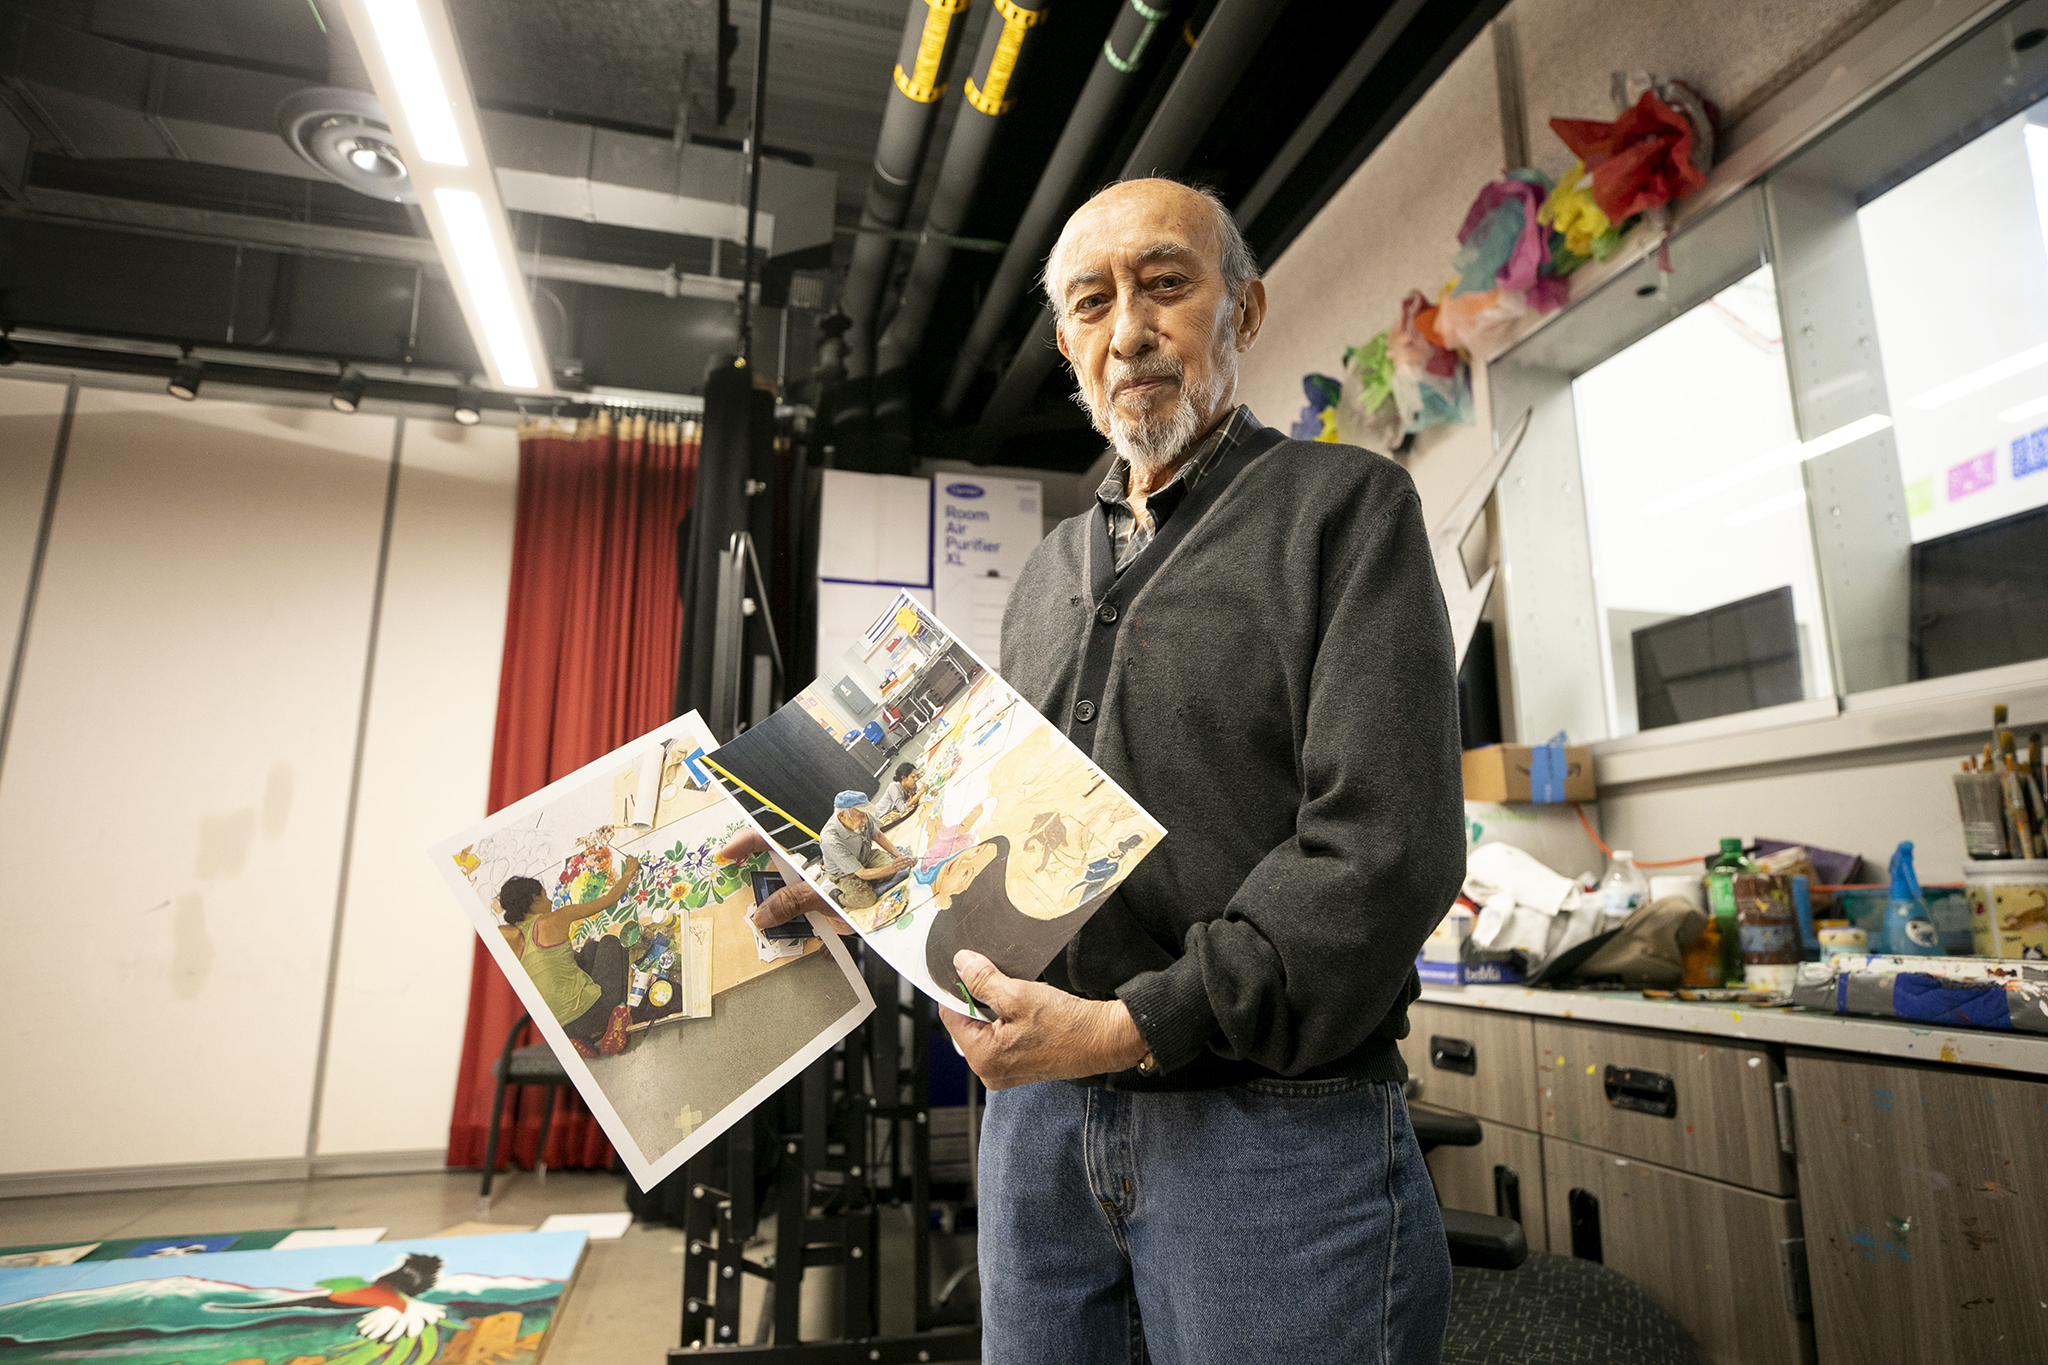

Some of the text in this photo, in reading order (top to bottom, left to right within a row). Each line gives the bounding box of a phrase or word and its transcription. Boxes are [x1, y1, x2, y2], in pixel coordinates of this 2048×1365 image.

[945, 504, 990, 521] Room
[945, 521, 967, 534] Air
[945, 535, 1001, 552] Purifier
[945, 553, 966, 566] XL
